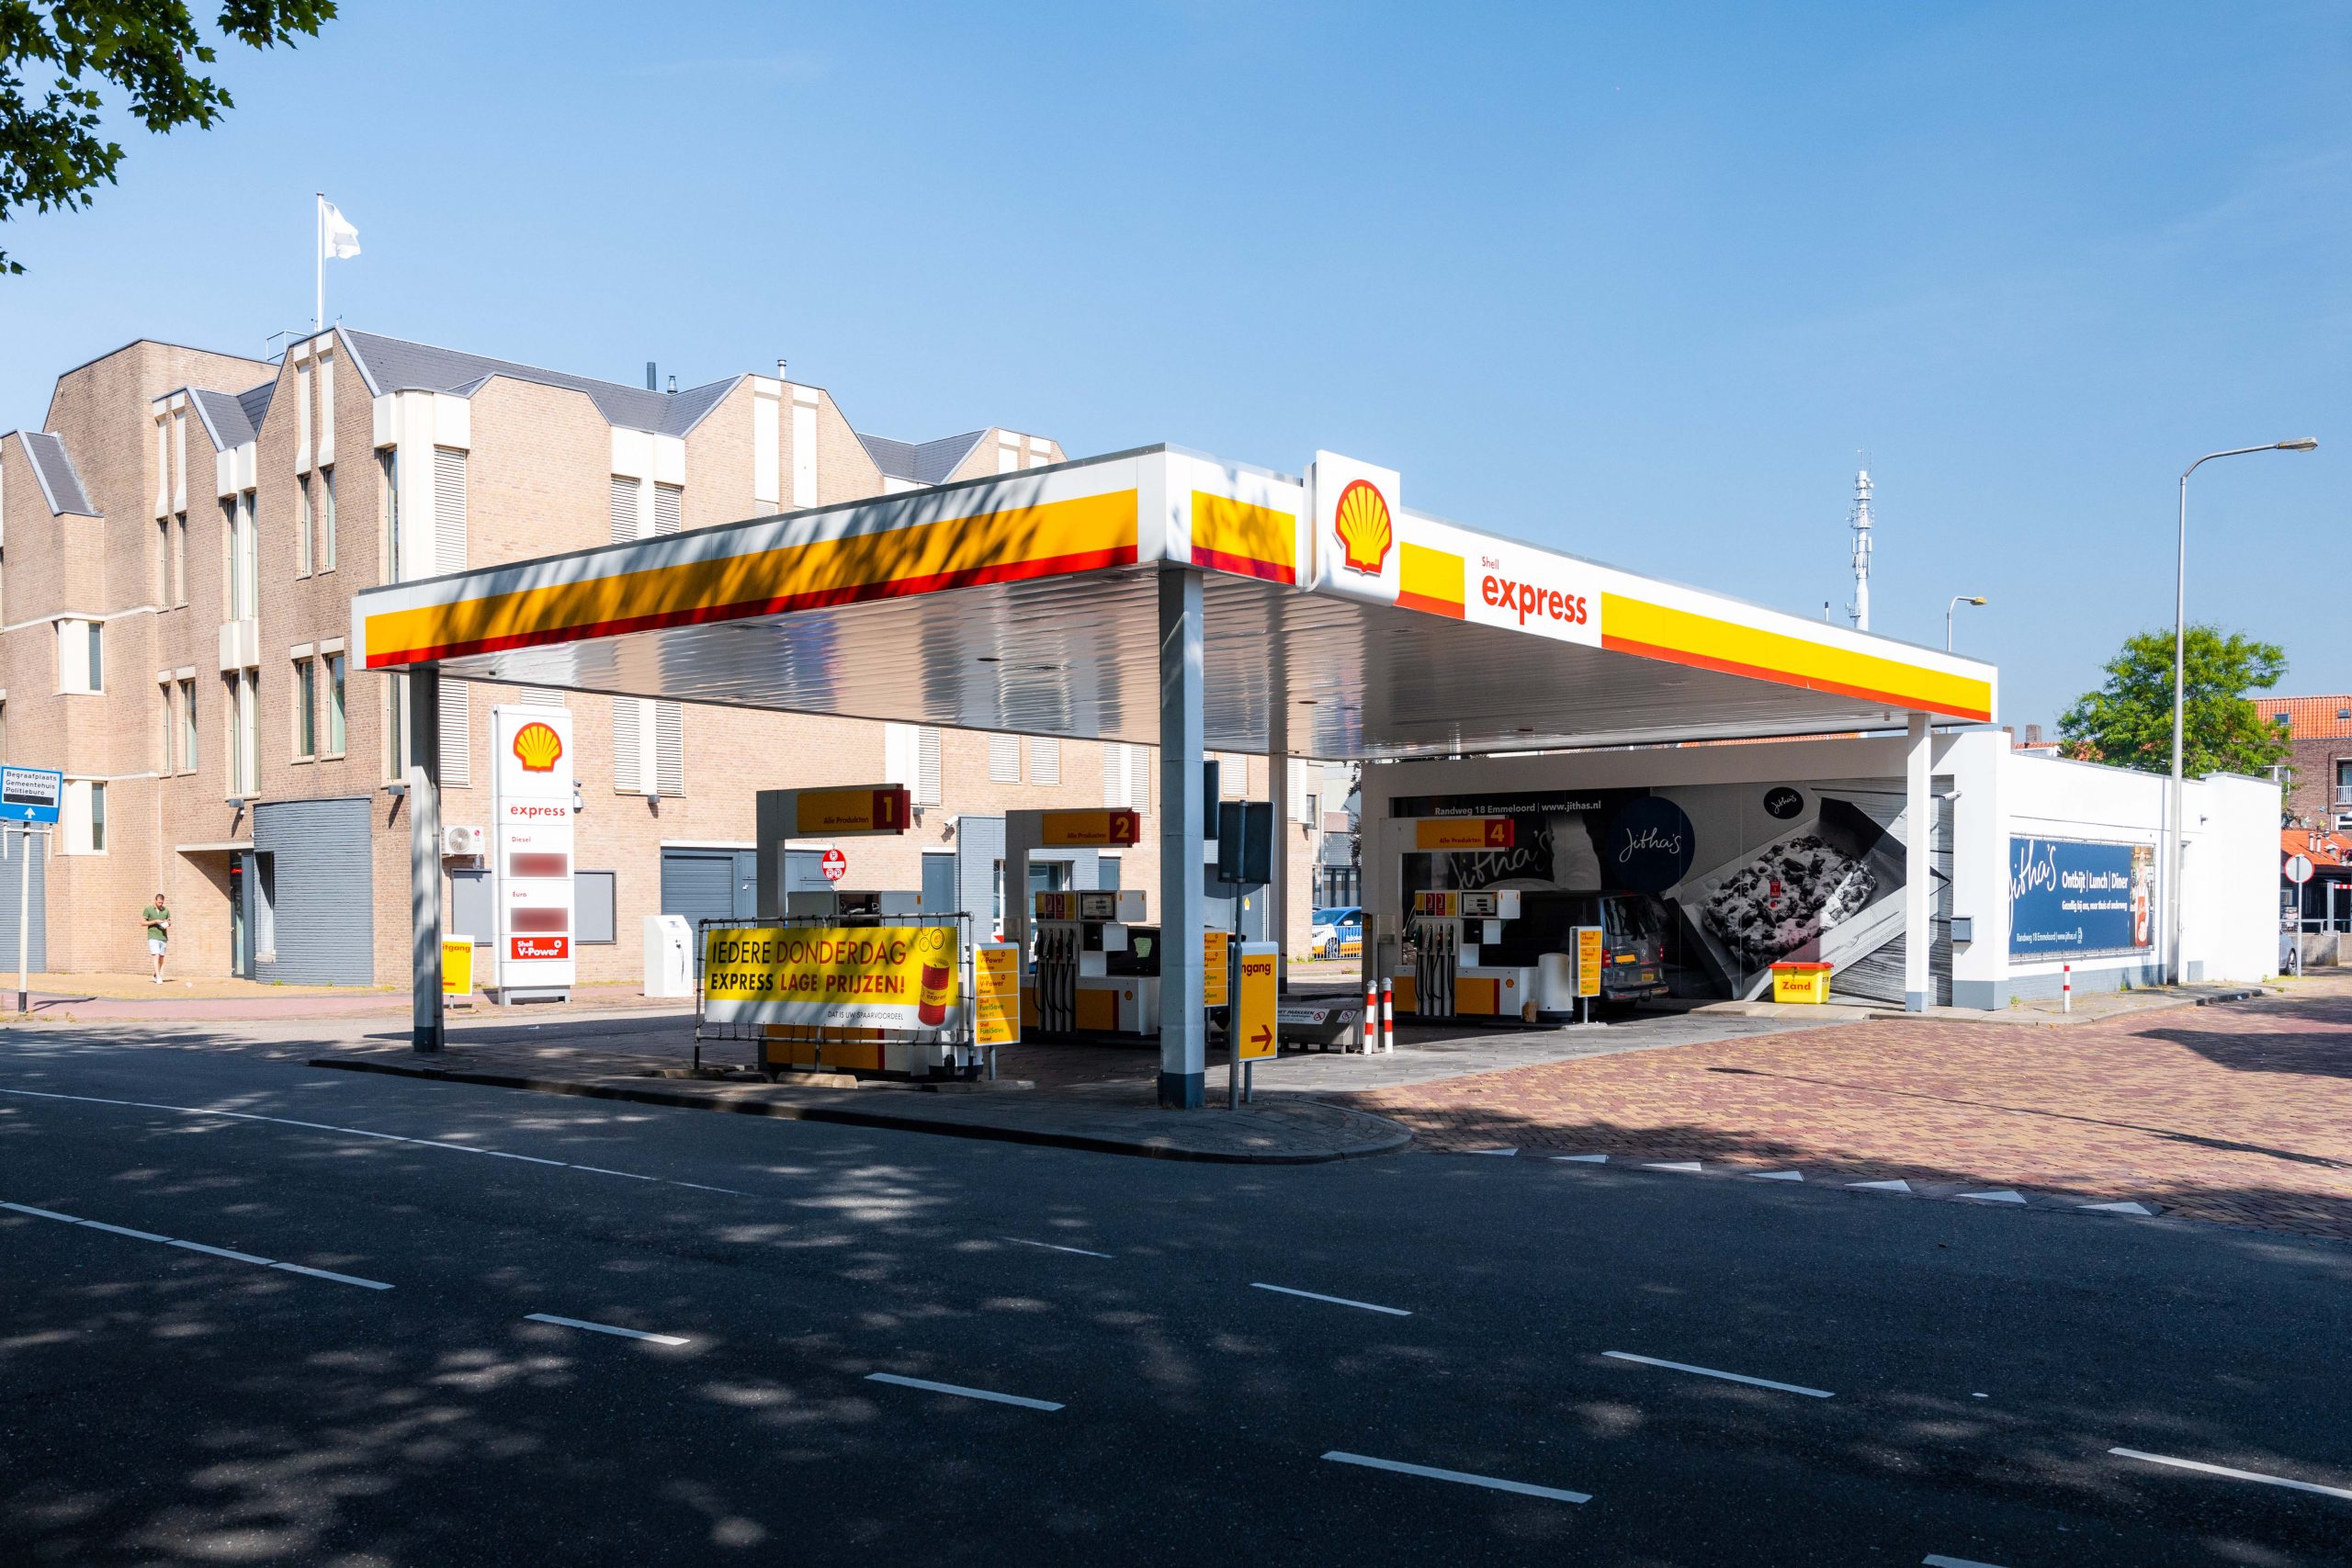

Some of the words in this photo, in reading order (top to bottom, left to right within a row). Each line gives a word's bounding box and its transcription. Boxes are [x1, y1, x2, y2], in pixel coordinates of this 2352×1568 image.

[1482, 556, 1499, 570] Shell
[1482, 575, 1588, 626] express
[6, 772, 57, 781] Begraafplaats
[6, 780, 55, 789] Gemeentehuis
[510, 806, 566, 818] express
[883, 796, 892, 822] 1
[1435, 807, 1472, 816] Randweg
[1476, 806, 1485, 814] 18
[1487, 804, 1536, 814] Emmeloord
[1542, 800, 1601, 813] www.jithas.nl
[1115, 817, 1129, 839] 2
[1490, 823, 1504, 842] 4
[1619, 827, 1682, 863] Jitha's
[2062, 870, 2086, 894] Ontbijt
[2089, 871, 2108, 889] Lunch
[2111, 872, 2129, 889] Diner
[442, 942, 470, 953] itgang
[517, 947, 559, 956] V-Power
[712, 941, 772, 964] IEDERE
[776, 940, 907, 965] DONDERDAG
[1241, 963, 1272, 976] ngang
[711, 973, 774, 991] EXPRESS
[781, 973, 818, 992] LAGE
[826, 974, 905, 995] PRIJZEN!
[1781, 981, 1811, 990] Zand
[856, 1011, 904, 1021] SPAARVOORDEEL
